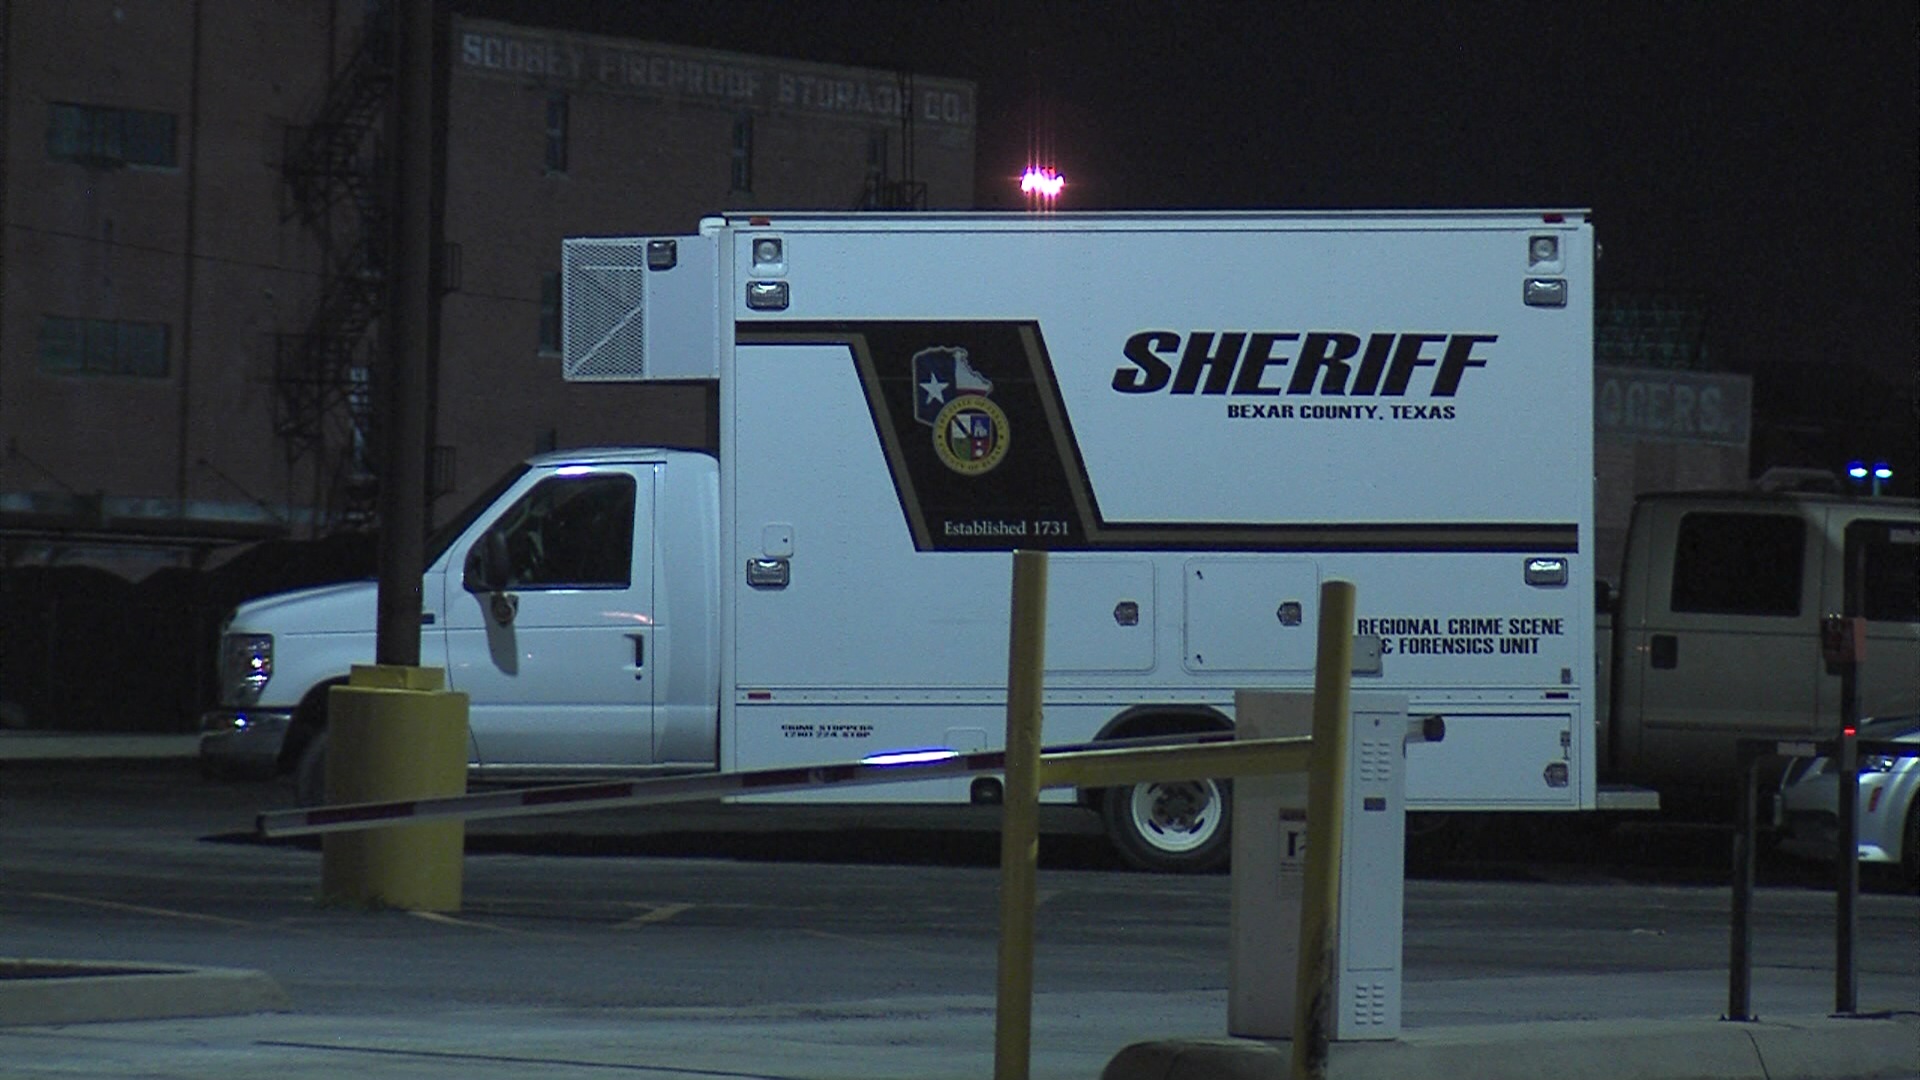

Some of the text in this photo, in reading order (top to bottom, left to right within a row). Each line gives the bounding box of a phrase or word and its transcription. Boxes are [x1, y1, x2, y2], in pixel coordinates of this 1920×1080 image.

[599, 51, 761, 97] FIREPROOF
[1111, 331, 1499, 397] SHERIFF
[1227, 404, 1295, 419] BEXAR
[1390, 405, 1456, 420] TEXAS
[944, 521, 1069, 535] Established 1731
[1357, 618, 1564, 636] REGIONAL CRIME SCENE
[1399, 638, 1495, 655] FORENSICS
[1499, 638, 1540, 655] UNIT
